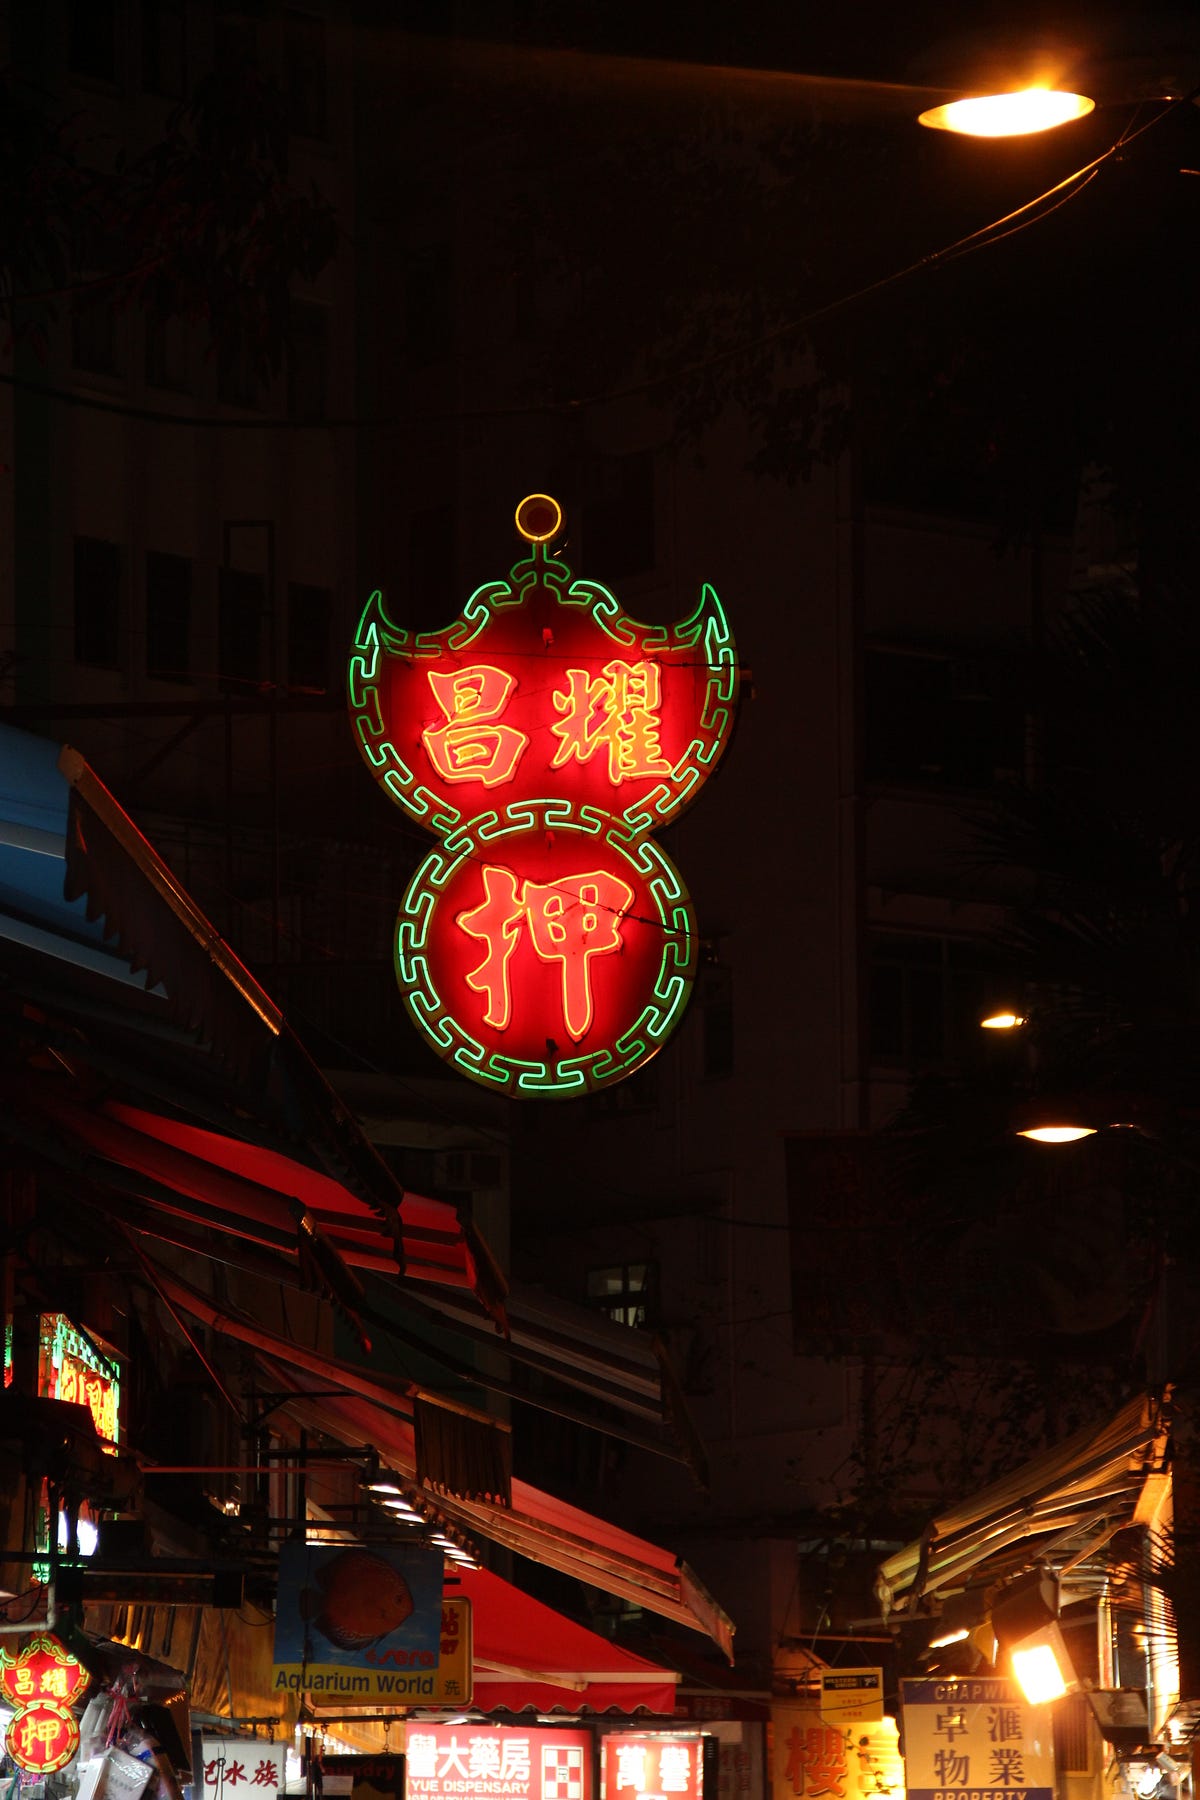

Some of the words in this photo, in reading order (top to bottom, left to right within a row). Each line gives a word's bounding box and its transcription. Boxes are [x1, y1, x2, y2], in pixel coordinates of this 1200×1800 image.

[422, 659, 676, 787] 昌耀
[455, 863, 635, 1042] 押
[378, 1649, 434, 1666] sera
[14, 1668, 69, 1698] 昌耀
[275, 1671, 370, 1692] Aquarium
[377, 1675, 433, 1695] World
[20, 1716, 61, 1761] 押
[785, 1727, 846, 1797] 櫻
[934, 1749, 1025, 1786] 物業
[411, 1780, 439, 1792] YUE
[443, 1781, 530, 1794] DISPENSARY
